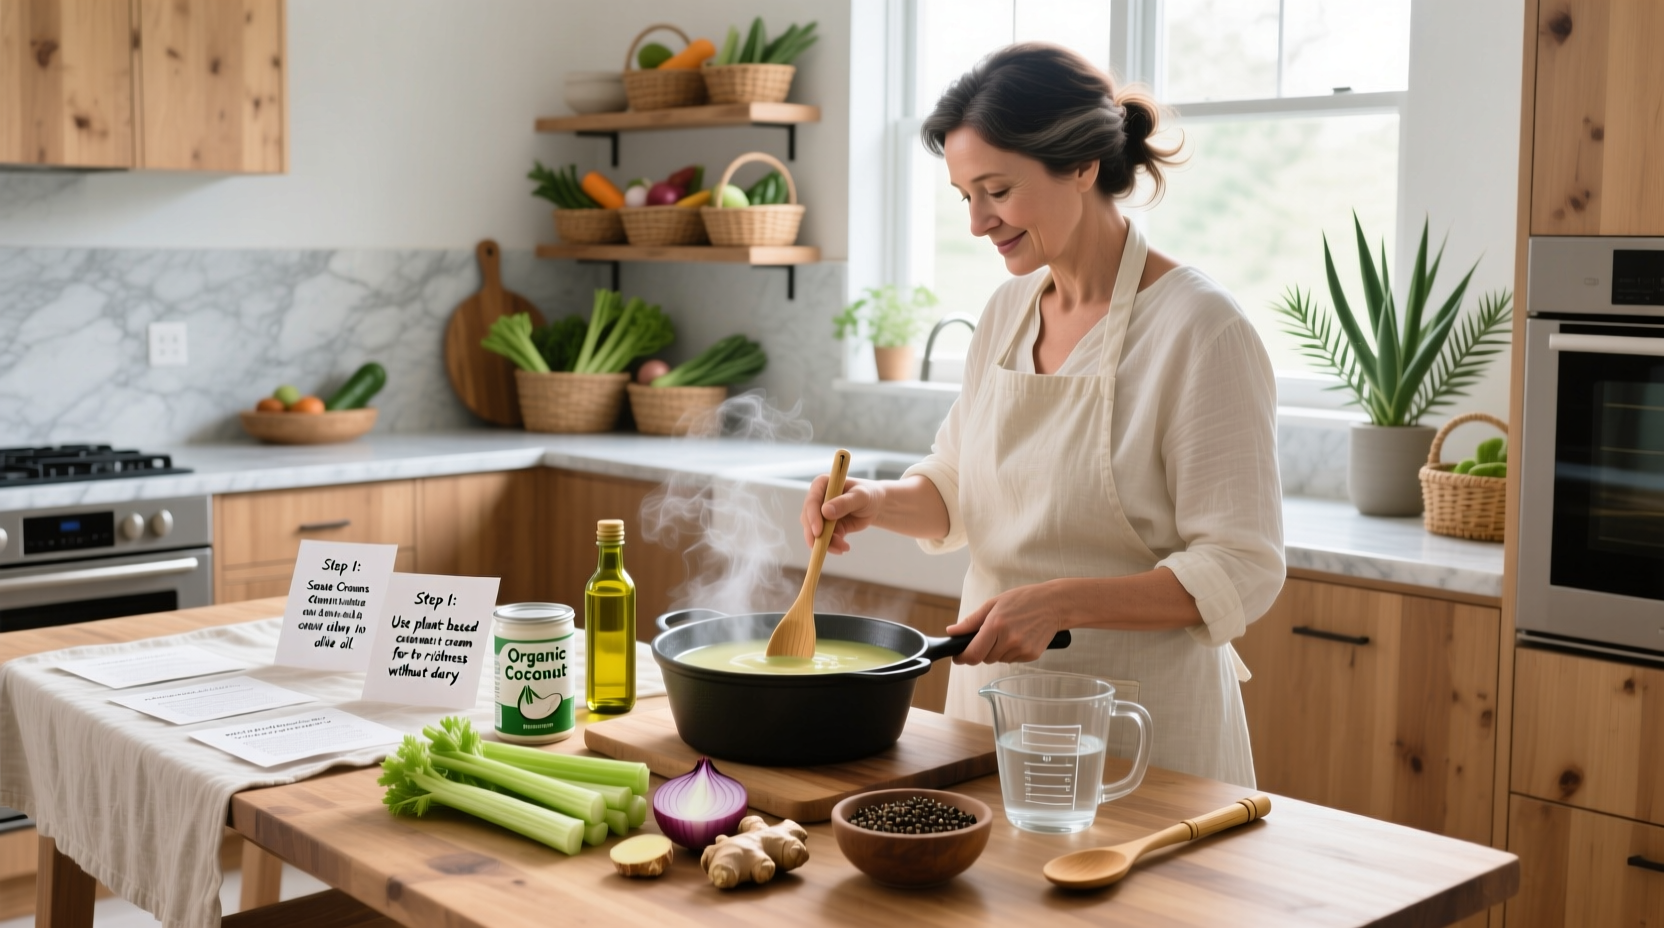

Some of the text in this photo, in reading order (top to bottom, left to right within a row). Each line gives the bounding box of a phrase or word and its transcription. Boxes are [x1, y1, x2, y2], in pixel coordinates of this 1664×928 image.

[414, 591, 444, 611] Step
[391, 614, 411, 629] Use
[507, 646, 567, 669] Organic
[504, 663, 568, 681] Coconut
